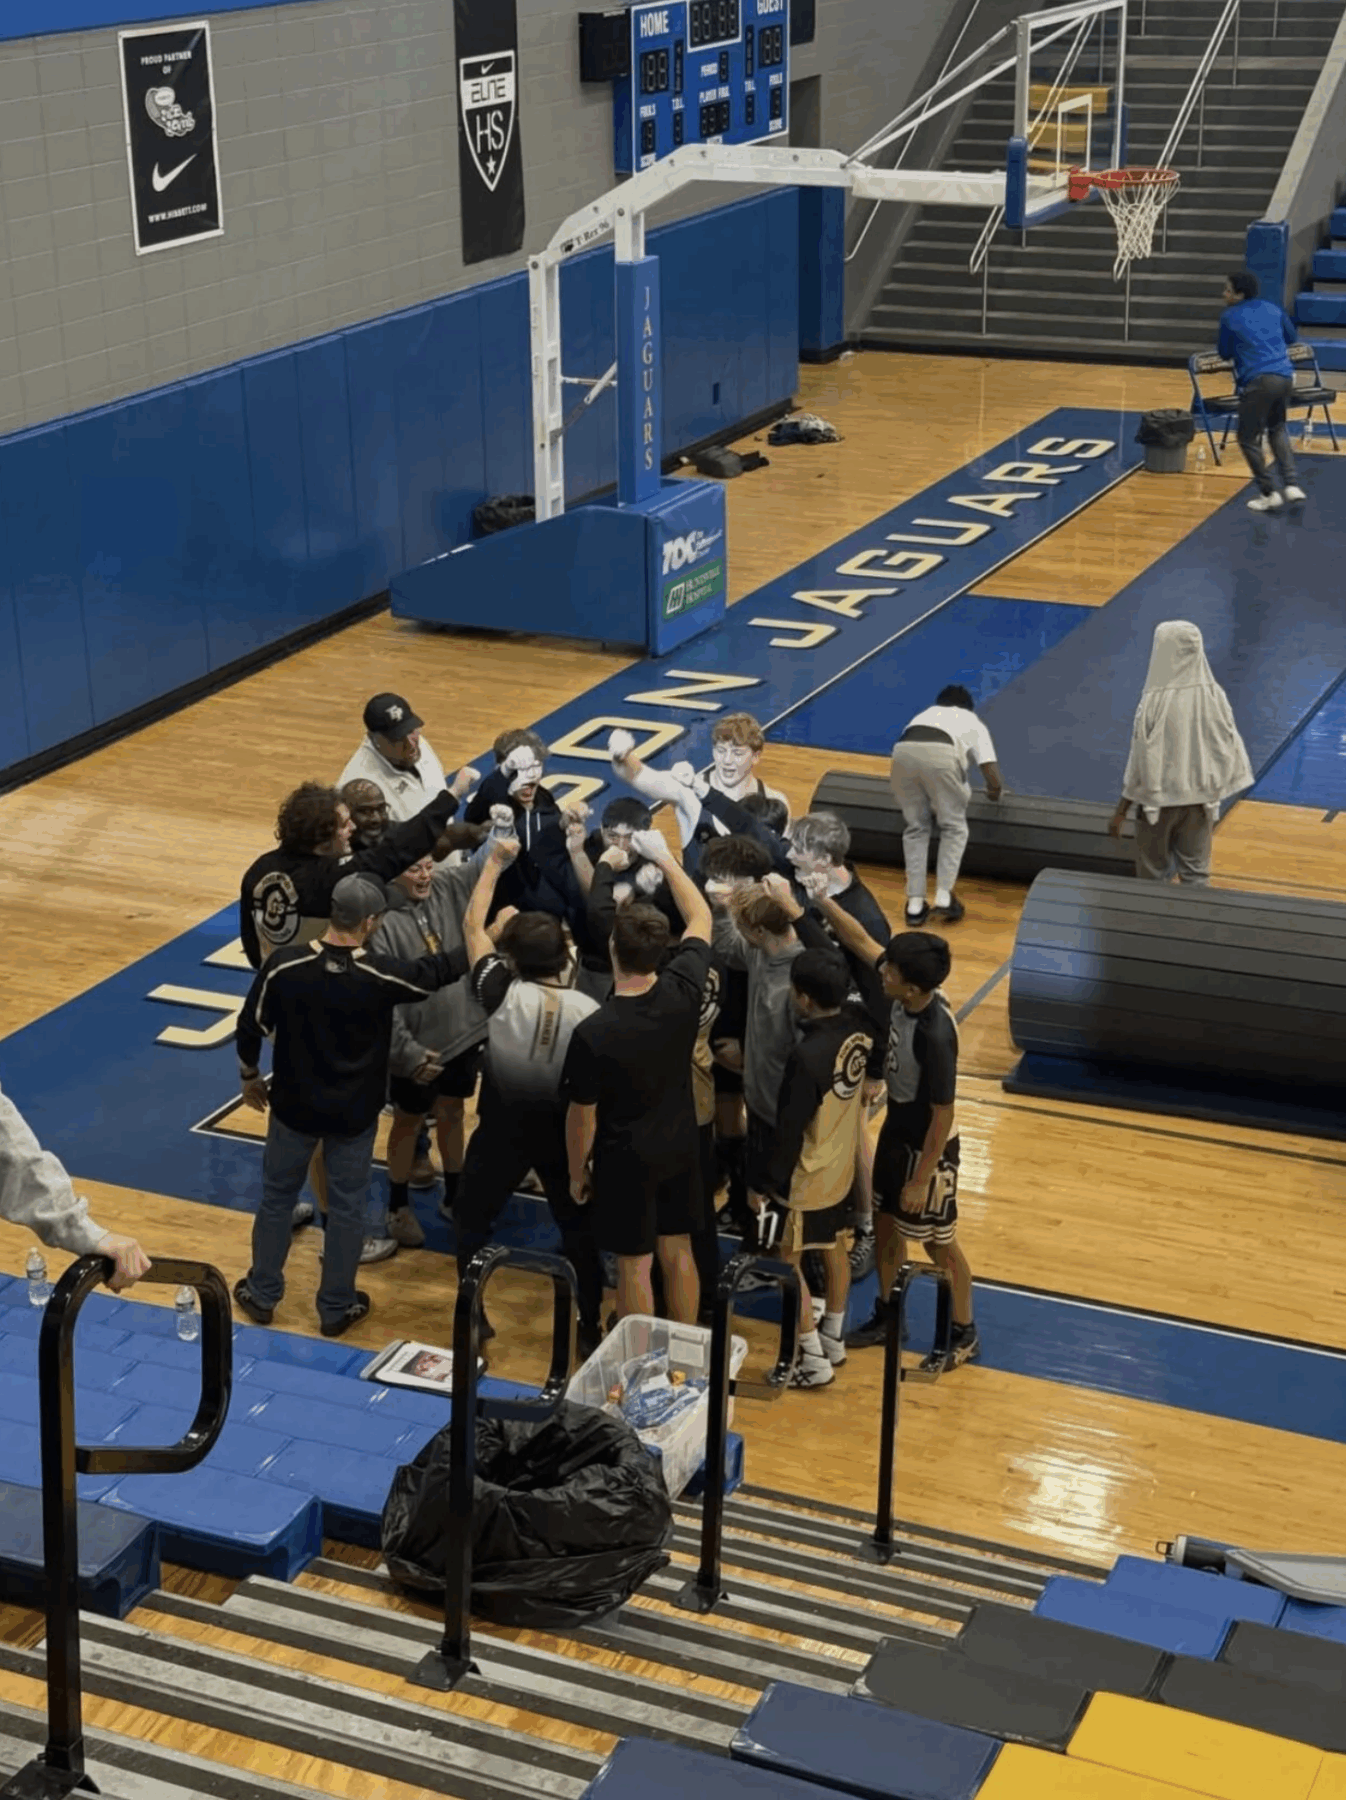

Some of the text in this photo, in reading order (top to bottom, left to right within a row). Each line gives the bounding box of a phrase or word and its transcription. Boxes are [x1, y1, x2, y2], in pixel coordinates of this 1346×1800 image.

[640, 11, 669, 38] HOME
[140, 50, 192, 66] PROUD PARTNER
[476, 110, 505, 153] HS
[643, 286, 653, 470] JAGUARS
[747, 437, 1116, 648] JAGUARS
